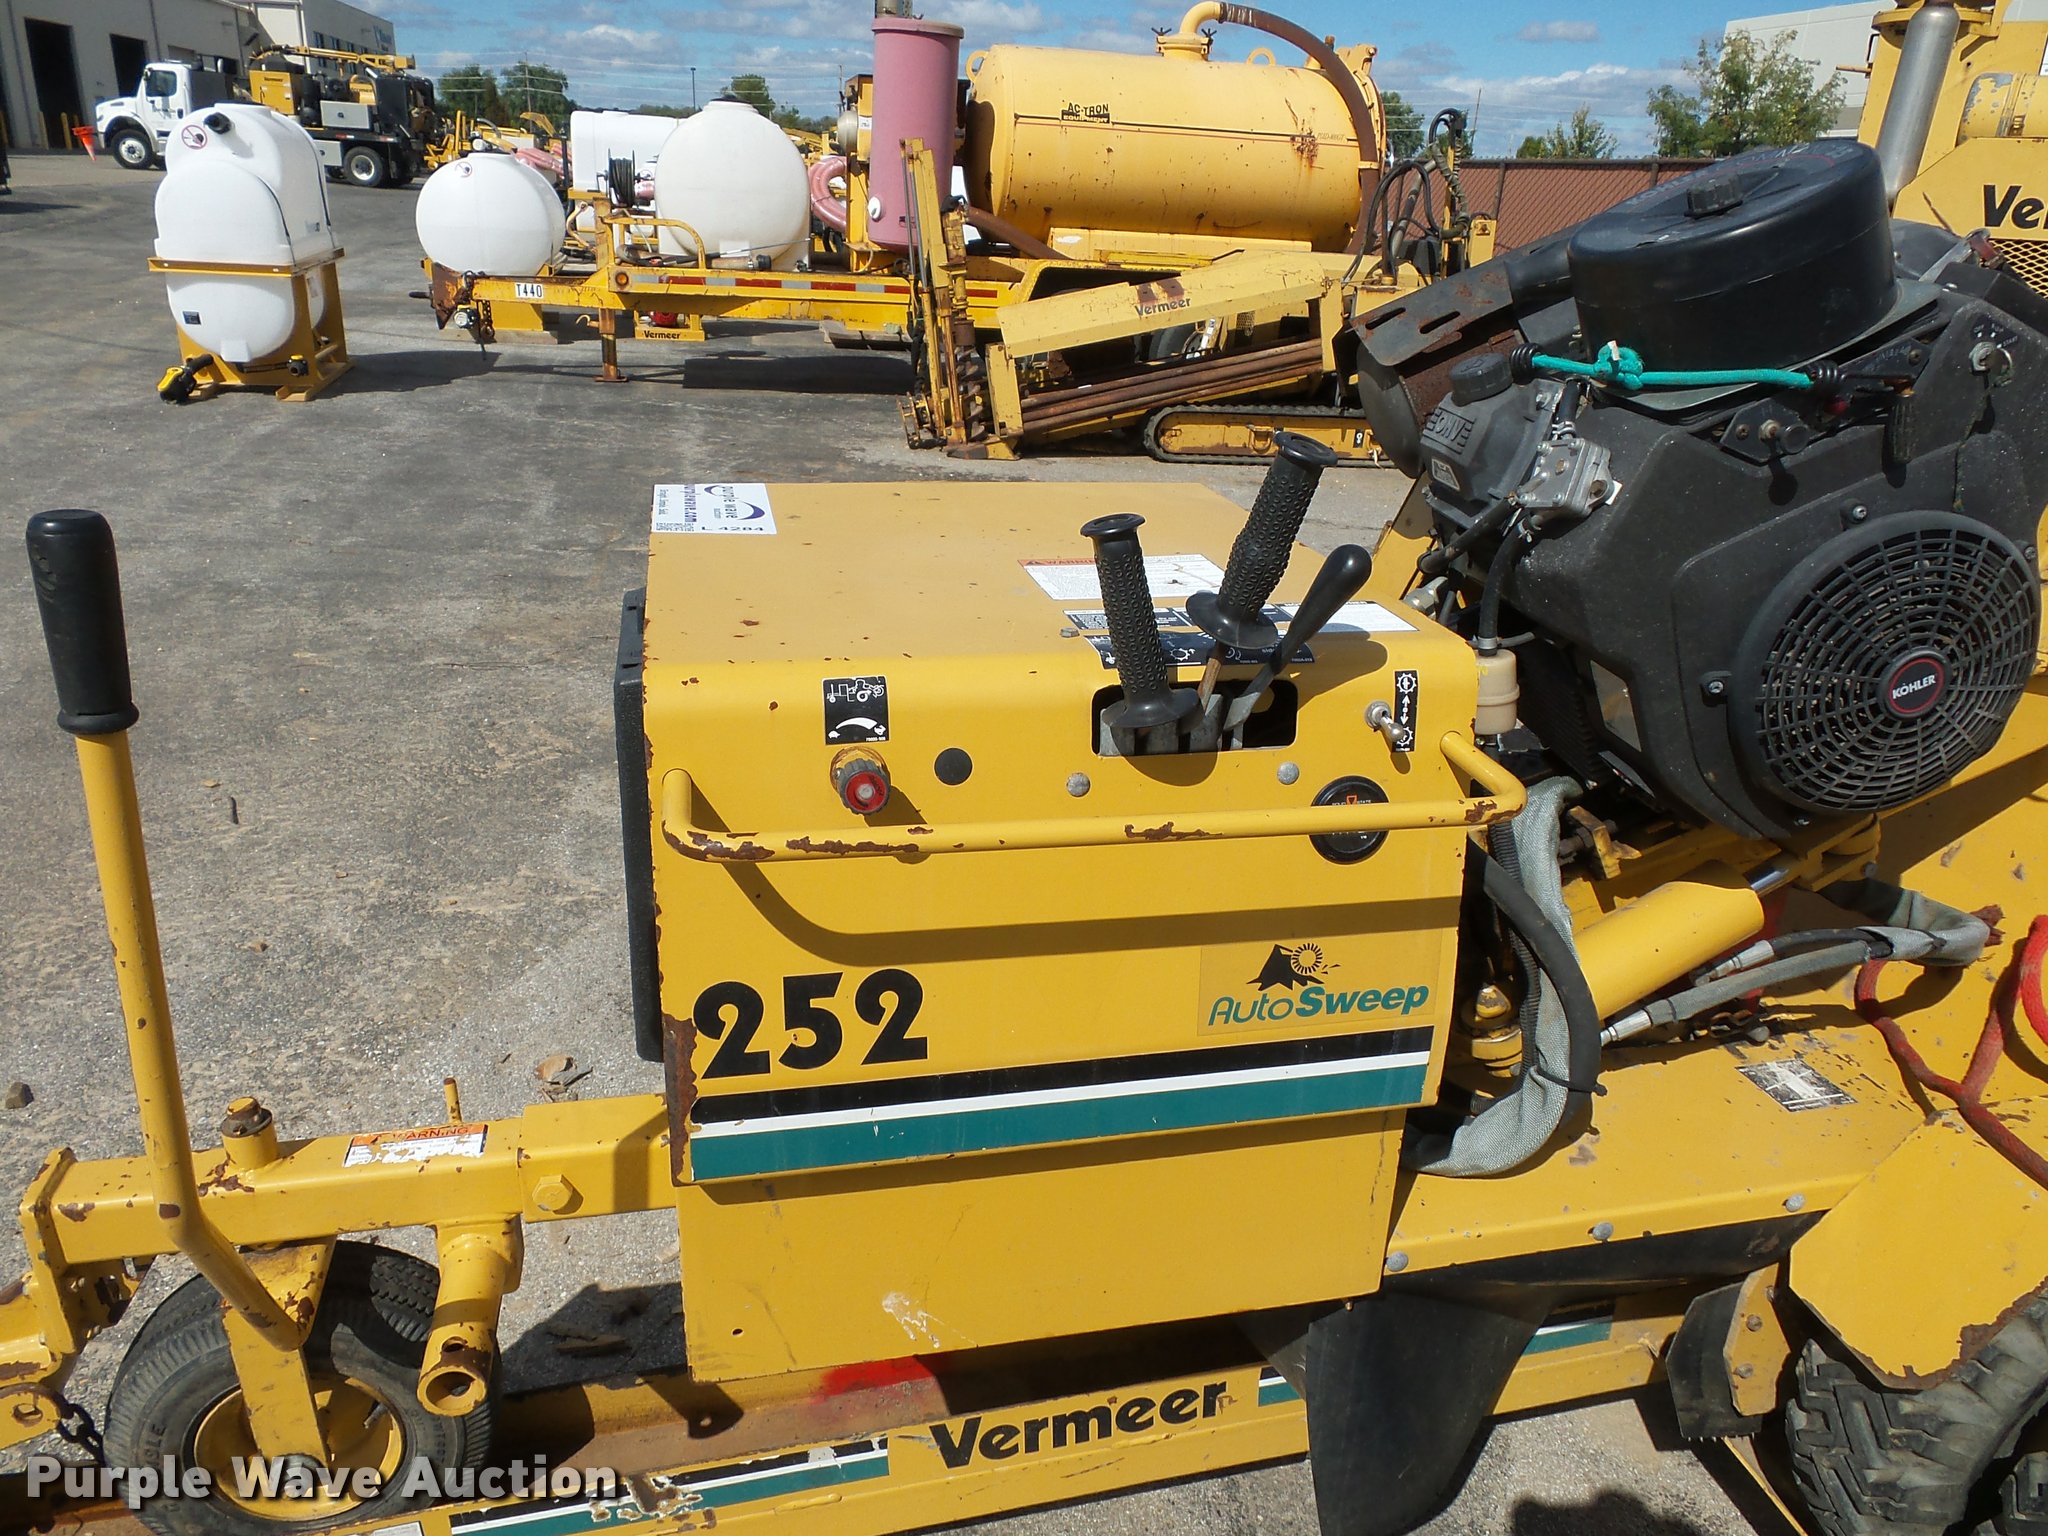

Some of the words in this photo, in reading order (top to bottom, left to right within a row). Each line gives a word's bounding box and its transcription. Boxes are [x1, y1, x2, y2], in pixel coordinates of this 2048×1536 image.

[1983, 184, 2048, 229] Ve
[516, 283, 543, 298] T440
[1134, 297, 1191, 316] Vermeer
[643, 330, 681, 339] Vermeer
[1892, 674, 1938, 700] KOHLER
[1208, 984, 1430, 1027] AutoSweep
[694, 968, 928, 1080] 252
[929, 1379, 1229, 1469] Vermeer
